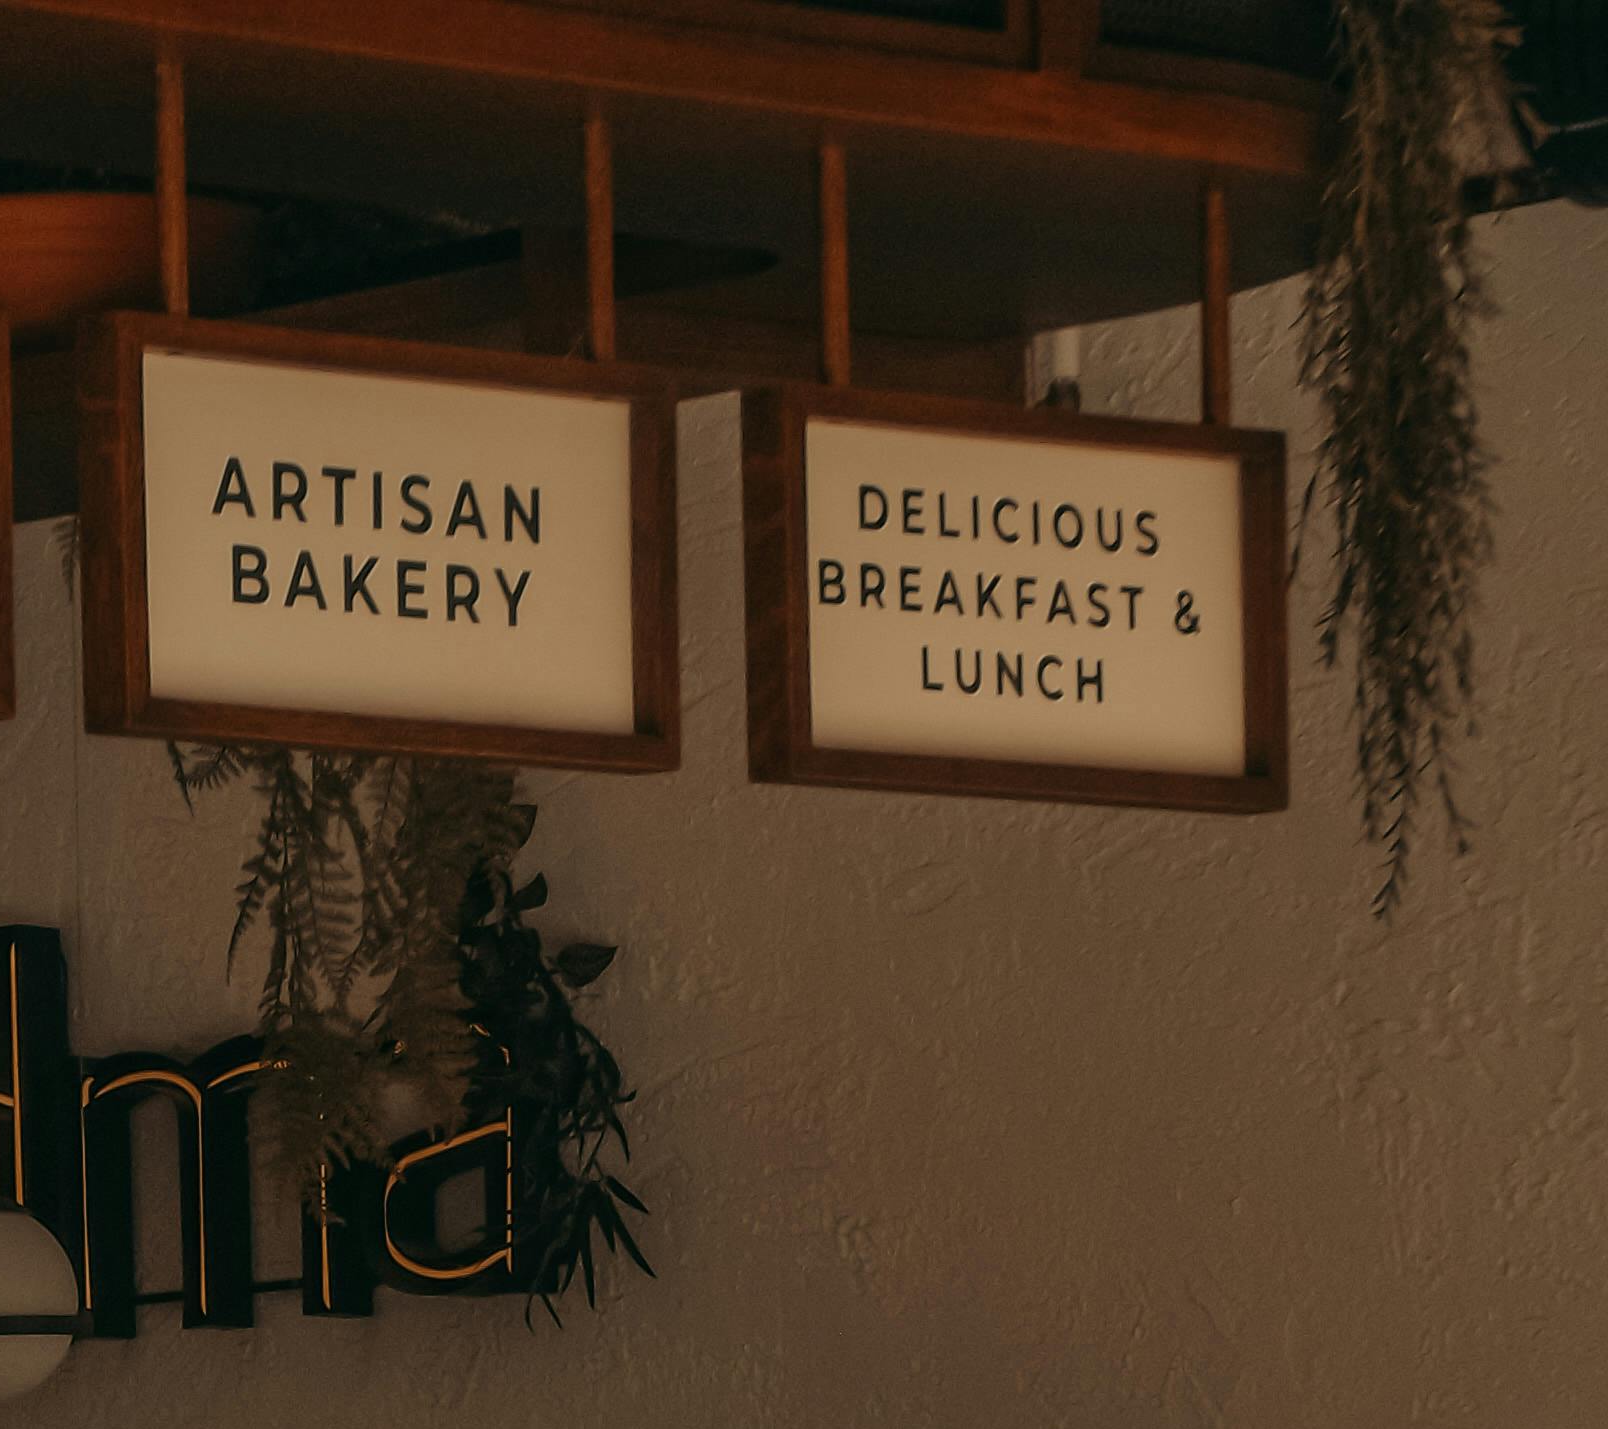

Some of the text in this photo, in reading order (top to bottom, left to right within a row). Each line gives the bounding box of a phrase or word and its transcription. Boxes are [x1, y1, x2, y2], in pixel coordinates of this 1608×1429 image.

[211, 456, 541, 544] ARTISAN
[858, 484, 1160, 556] DELICIOUS
[231, 543, 532, 627] BAKERY
[818, 558, 1202, 635] BREAKFAST &
[921, 644, 1104, 703] LUNCH
